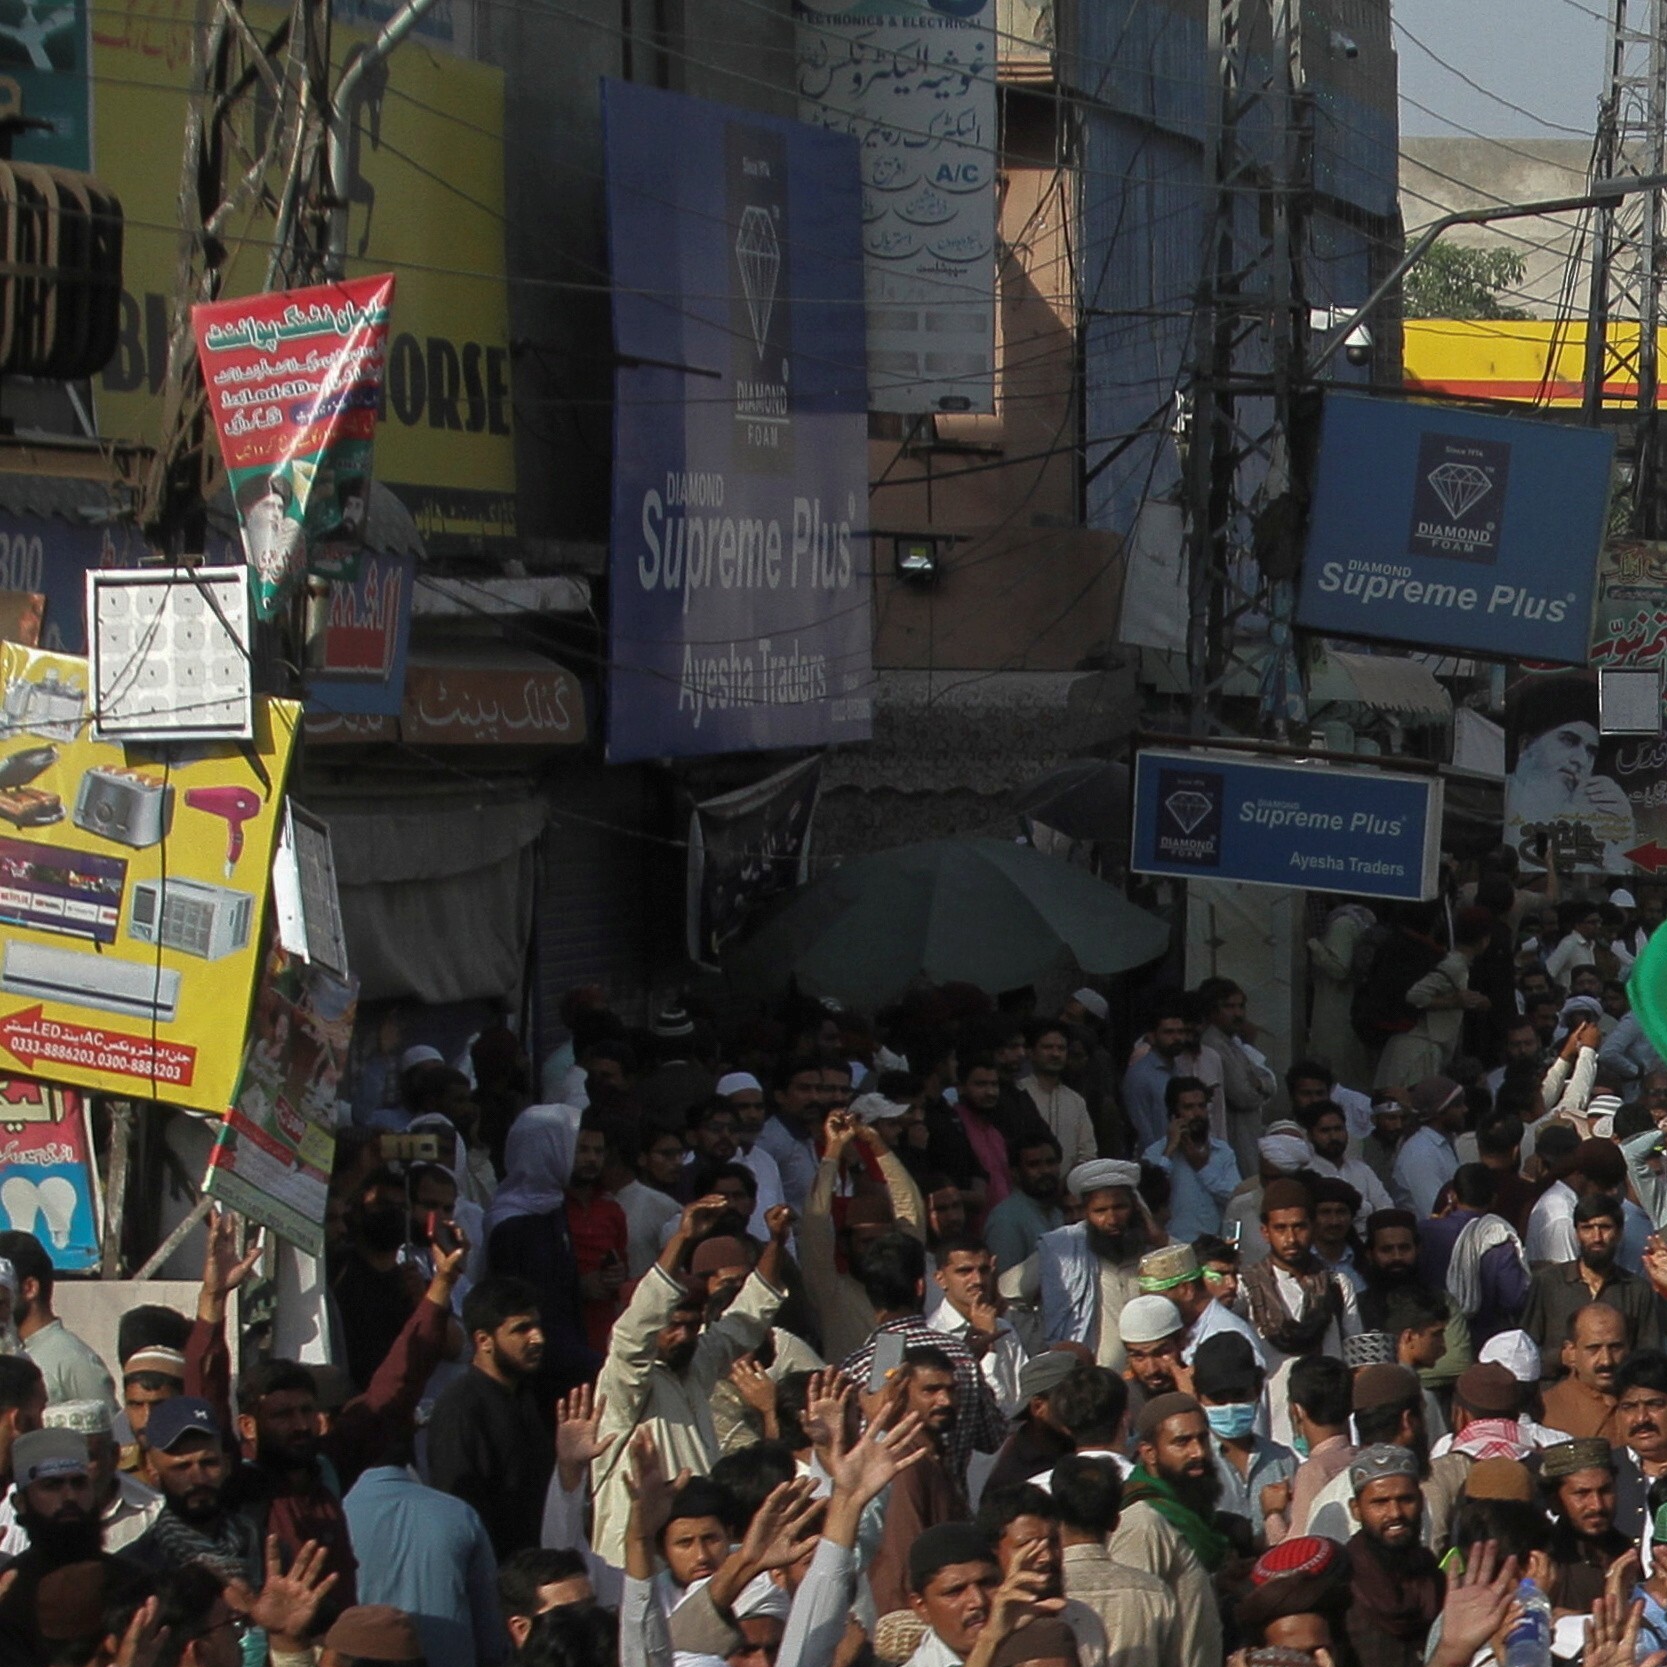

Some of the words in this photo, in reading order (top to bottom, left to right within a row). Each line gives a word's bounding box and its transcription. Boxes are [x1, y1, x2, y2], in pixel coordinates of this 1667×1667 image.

[936, 163, 979, 183] A/C
[736, 380, 788, 416] DIAMOND
[747, 424, 778, 448] FOAM
[666, 470, 724, 508] DIAMOND
[1418, 521, 1491, 543] DIAMOND
[639, 488, 782, 616] Supreme
[791, 496, 852, 590] Plus
[1431, 538, 1475, 553] FOAM
[1347, 559, 1412, 579] DIAMOND
[1318, 561, 1478, 611] Supreme
[1487, 584, 1568, 622] Plus
[678, 643, 755, 730] Ayesha
[759, 638, 827, 704] Traders
[1239, 801, 1344, 831] Supreme
[1350, 812, 1402, 837] Plus
[1160, 836, 1215, 851] DIAMOND
[1289, 851, 1345, 872] Ayesha
[1349, 856, 1406, 878] Traders
[32, 1021, 61, 1038] LED
[82, 1030, 104, 1047] AC
